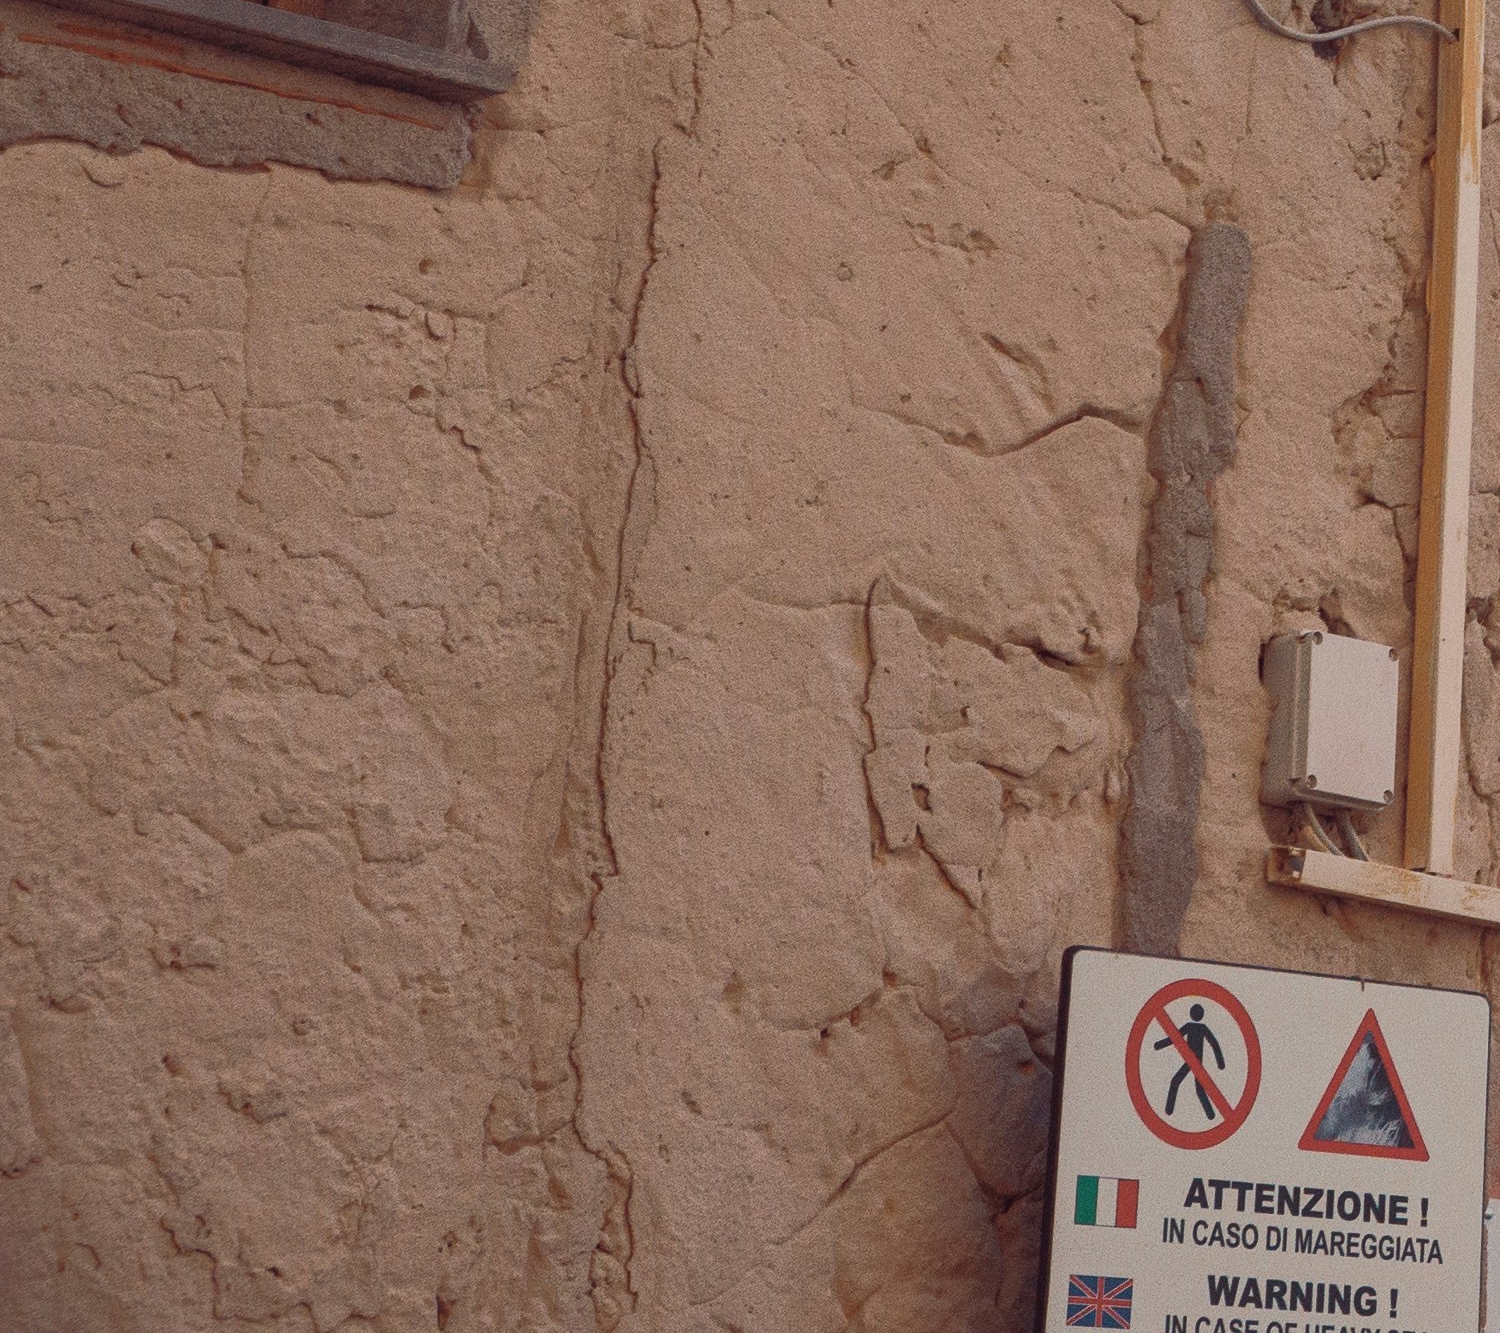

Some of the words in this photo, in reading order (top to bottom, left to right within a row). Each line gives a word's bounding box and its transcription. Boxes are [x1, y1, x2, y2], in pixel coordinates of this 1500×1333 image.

[1183, 1177, 1409, 1226] ATTENZIONE
[1162, 1217, 1186, 1244] IN
[1192, 1220, 1259, 1250] CASO
[1265, 1225, 1289, 1253] DI
[1294, 1227, 1444, 1265] MAREGGIATA
[1207, 1274, 1378, 1318] WARNING
